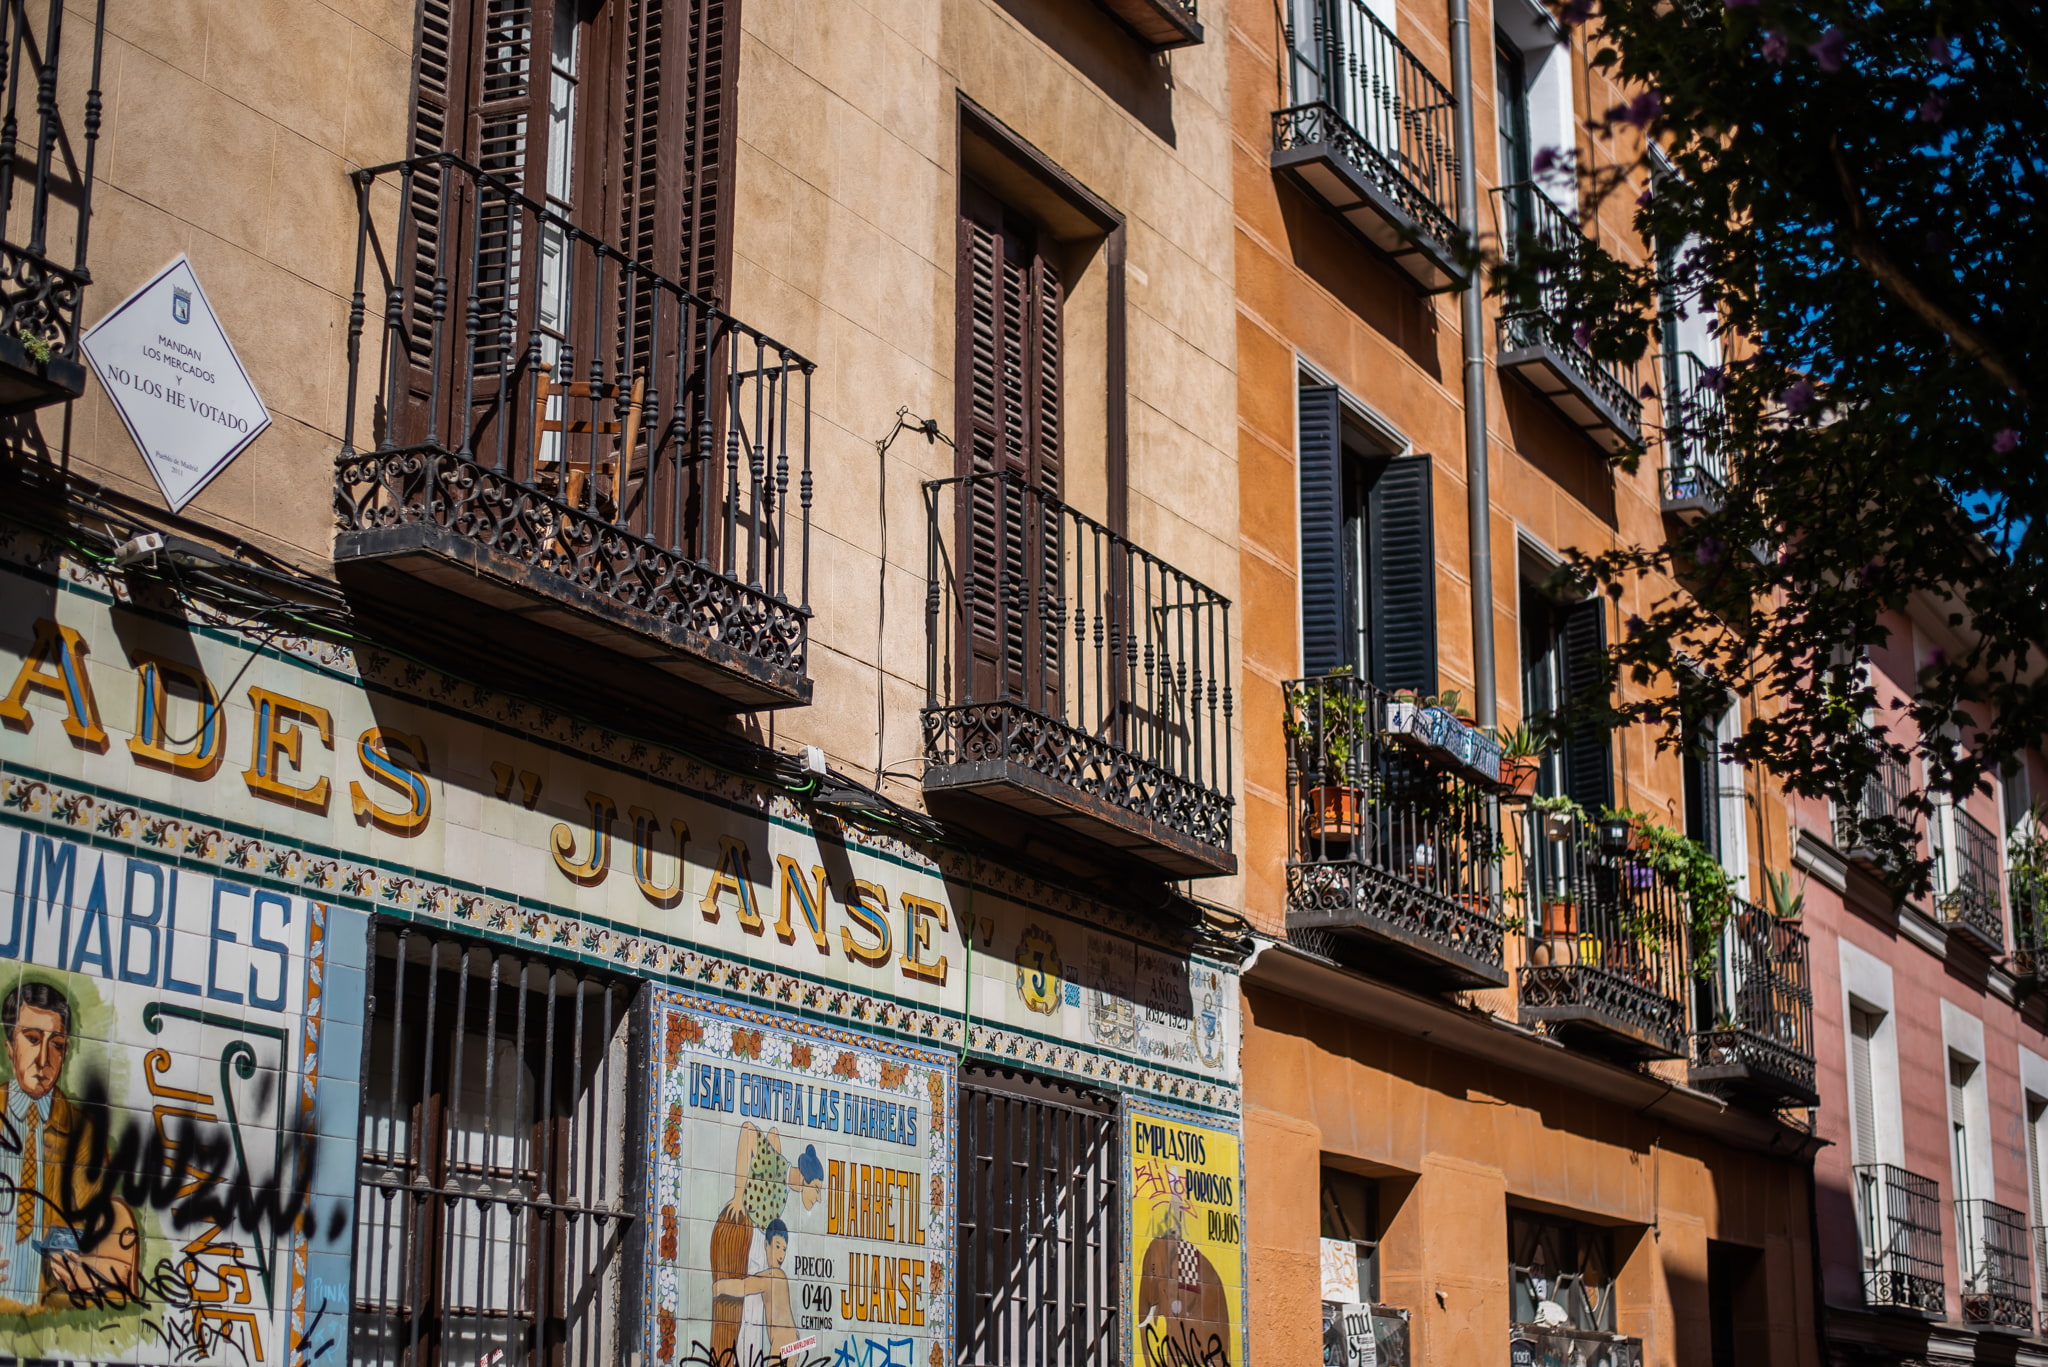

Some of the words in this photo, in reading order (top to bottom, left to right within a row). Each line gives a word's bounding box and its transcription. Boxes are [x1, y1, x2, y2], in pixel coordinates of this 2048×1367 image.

[143, 345, 161, 361] LOS
[163, 354, 215, 384] MERCADOS
[158, 335, 201, 361] MANDAN
[107, 364, 131, 385] NO
[134, 375, 162, 399] LOS
[166, 388, 186, 409] HE
[190, 398, 248, 433] VOTADO
[176, 375, 182, 386] Y
[1150, 976, 1179, 1005] AÑOS
[689, 1062, 735, 1114] USAD
[740, 1072, 804, 1126] CONTRA
[807, 1085, 840, 1132] LAS
[843, 1092, 918, 1147] DIARREAS
[1135, 1121, 1206, 1166] EMPLASTOS
[827, 1159, 926, 1246] DIARRETIL
[1186, 1169, 1233, 1207] POROSOS
[1208, 1209, 1239, 1245] ROJOS
[841, 1252, 925, 1327] JUANSE
[801, 1315, 833, 1330] CENTIMOS
[781, 1344, 794, 1355] PLAZA
[793, 1336, 816, 1352] WORLDWIDE
